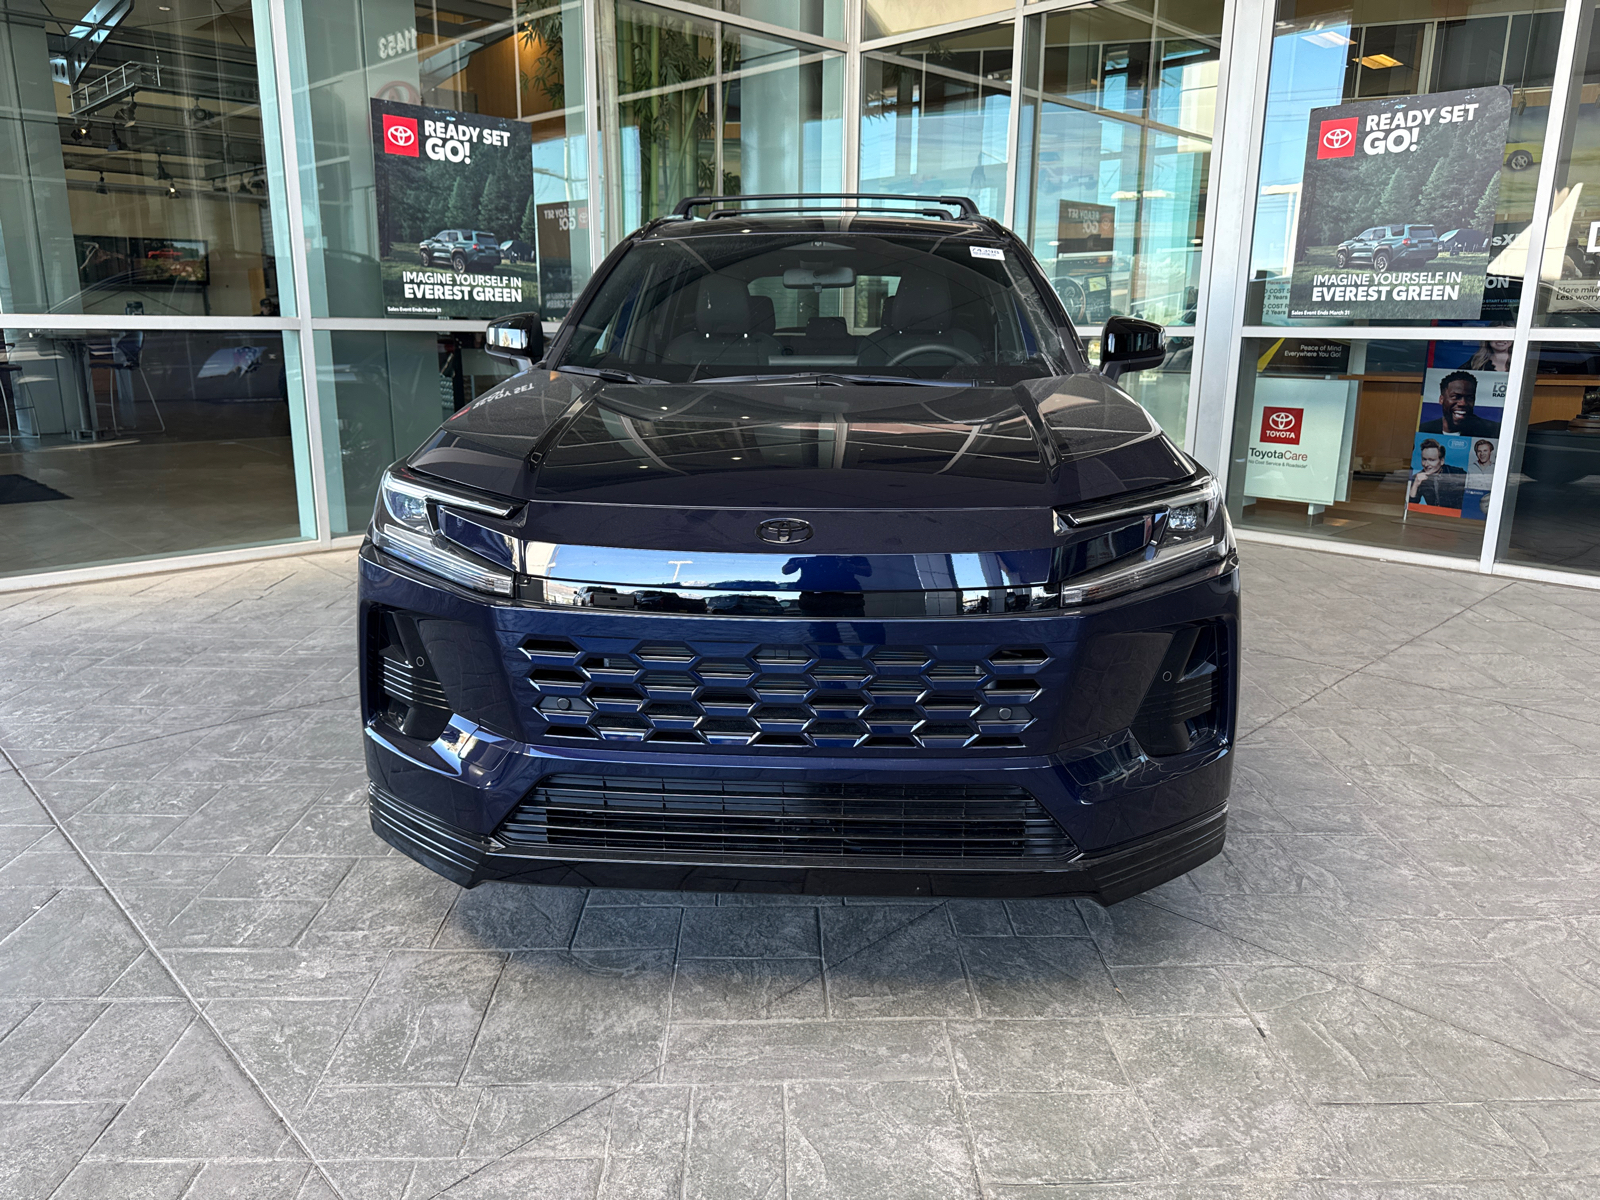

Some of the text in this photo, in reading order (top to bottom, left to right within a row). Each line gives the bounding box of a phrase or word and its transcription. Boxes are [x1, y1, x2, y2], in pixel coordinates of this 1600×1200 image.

[1365, 103, 1480, 132] READY SET
[424, 119, 511, 147] READY SET
[1363, 127, 1420, 156] GO!
[425, 137, 471, 165] GO!
[402, 271, 522, 288] IMAGINE YOURSELF IN
[1313, 271, 1463, 286] IMAGINE YOURSELF IN
[403, 284, 523, 303] EVEREST GREEN
[1311, 285, 1460, 302] EVEREST GREEN
[1284, 350, 1318, 358] Everywhere
[1265, 430, 1296, 439] TOYOTA
[1249, 447, 1308, 462] ToyotaCare
